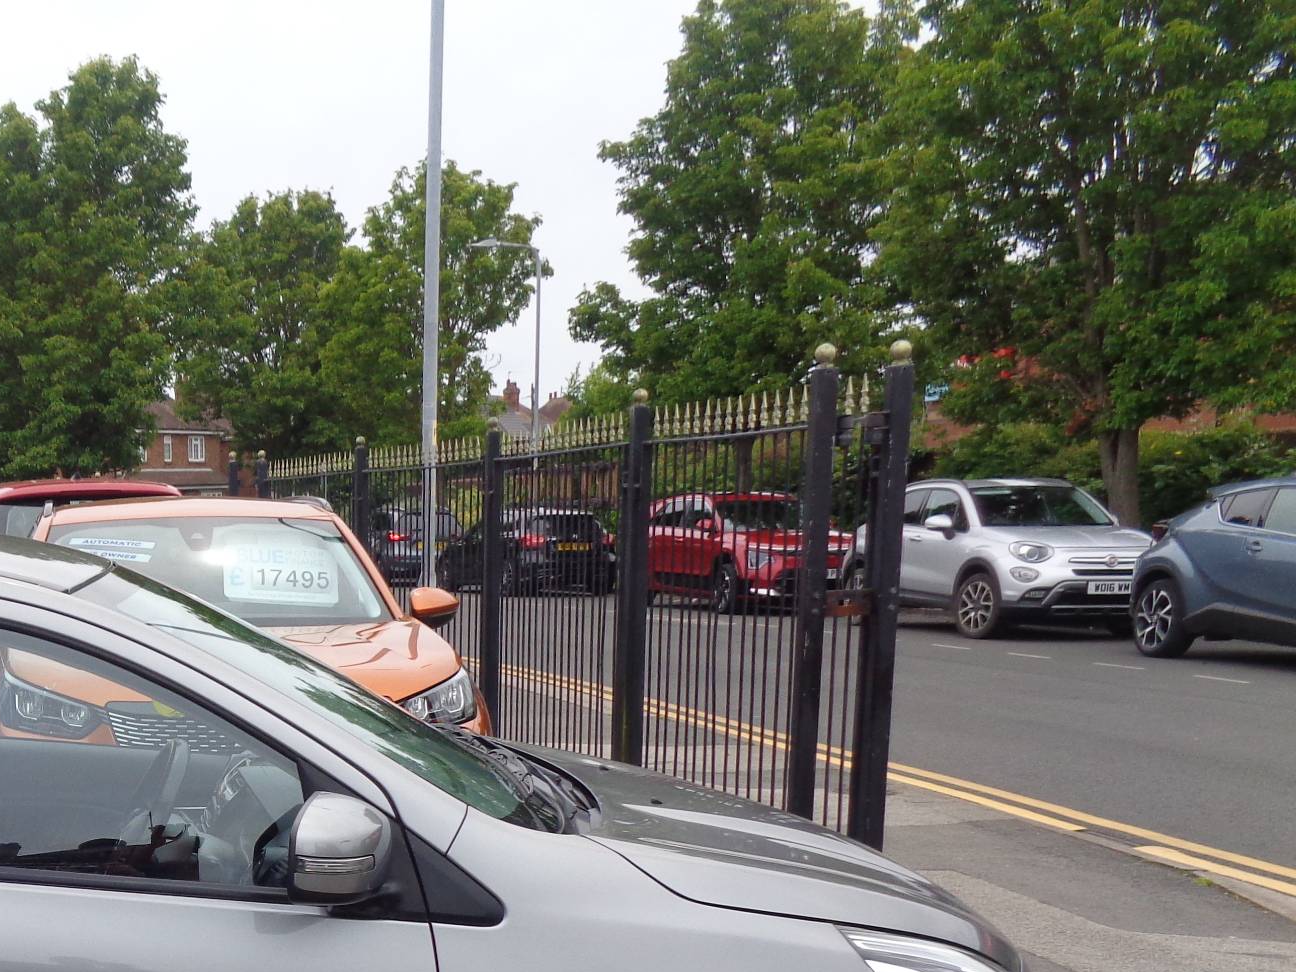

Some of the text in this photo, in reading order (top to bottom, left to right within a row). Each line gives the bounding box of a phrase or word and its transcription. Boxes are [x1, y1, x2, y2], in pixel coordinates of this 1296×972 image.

[81, 539, 142, 547] AUTOMATIC
[100, 552, 137, 560] OWNER
[256, 568, 330, 590] 17495
[1117, 583, 1131, 593] WM
